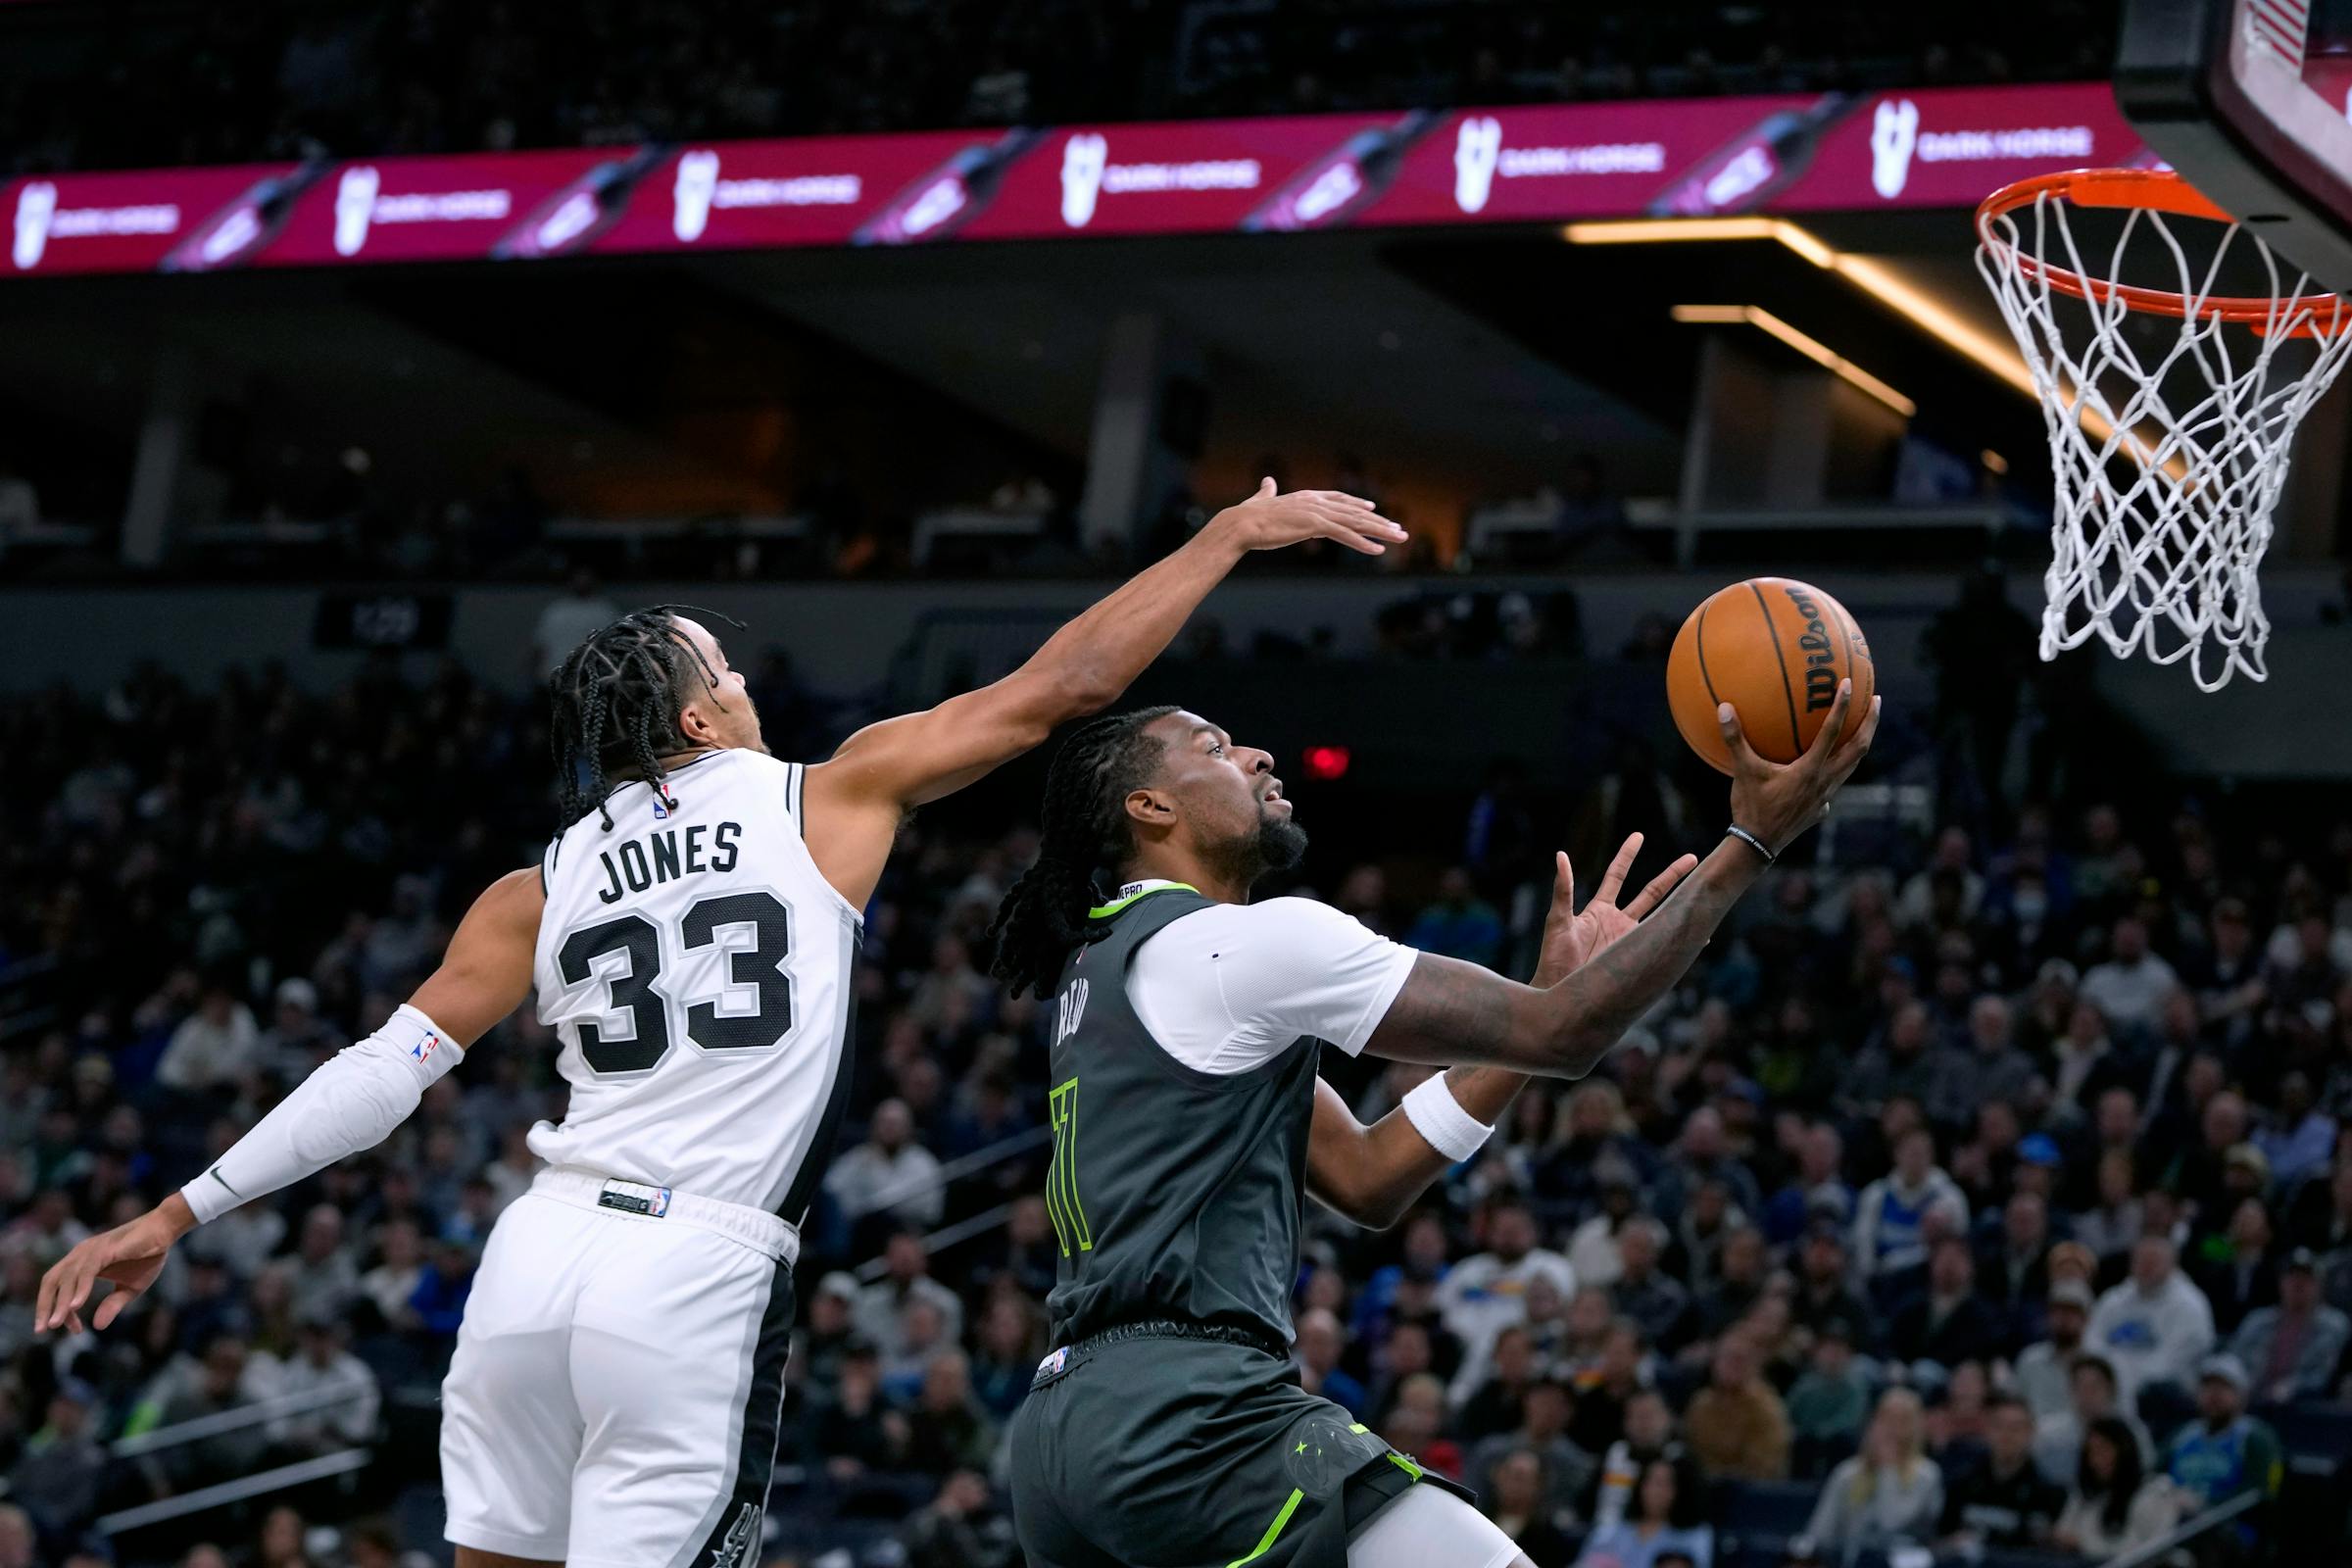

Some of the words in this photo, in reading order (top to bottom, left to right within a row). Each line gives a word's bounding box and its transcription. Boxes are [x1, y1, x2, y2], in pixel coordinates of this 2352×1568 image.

[1785, 587, 1838, 713] Wilson
[598, 821, 742, 905] JONES
[553, 885, 799, 1081] 33
[1056, 978, 1089, 1047] REID
[1046, 1076, 1092, 1257] 11
